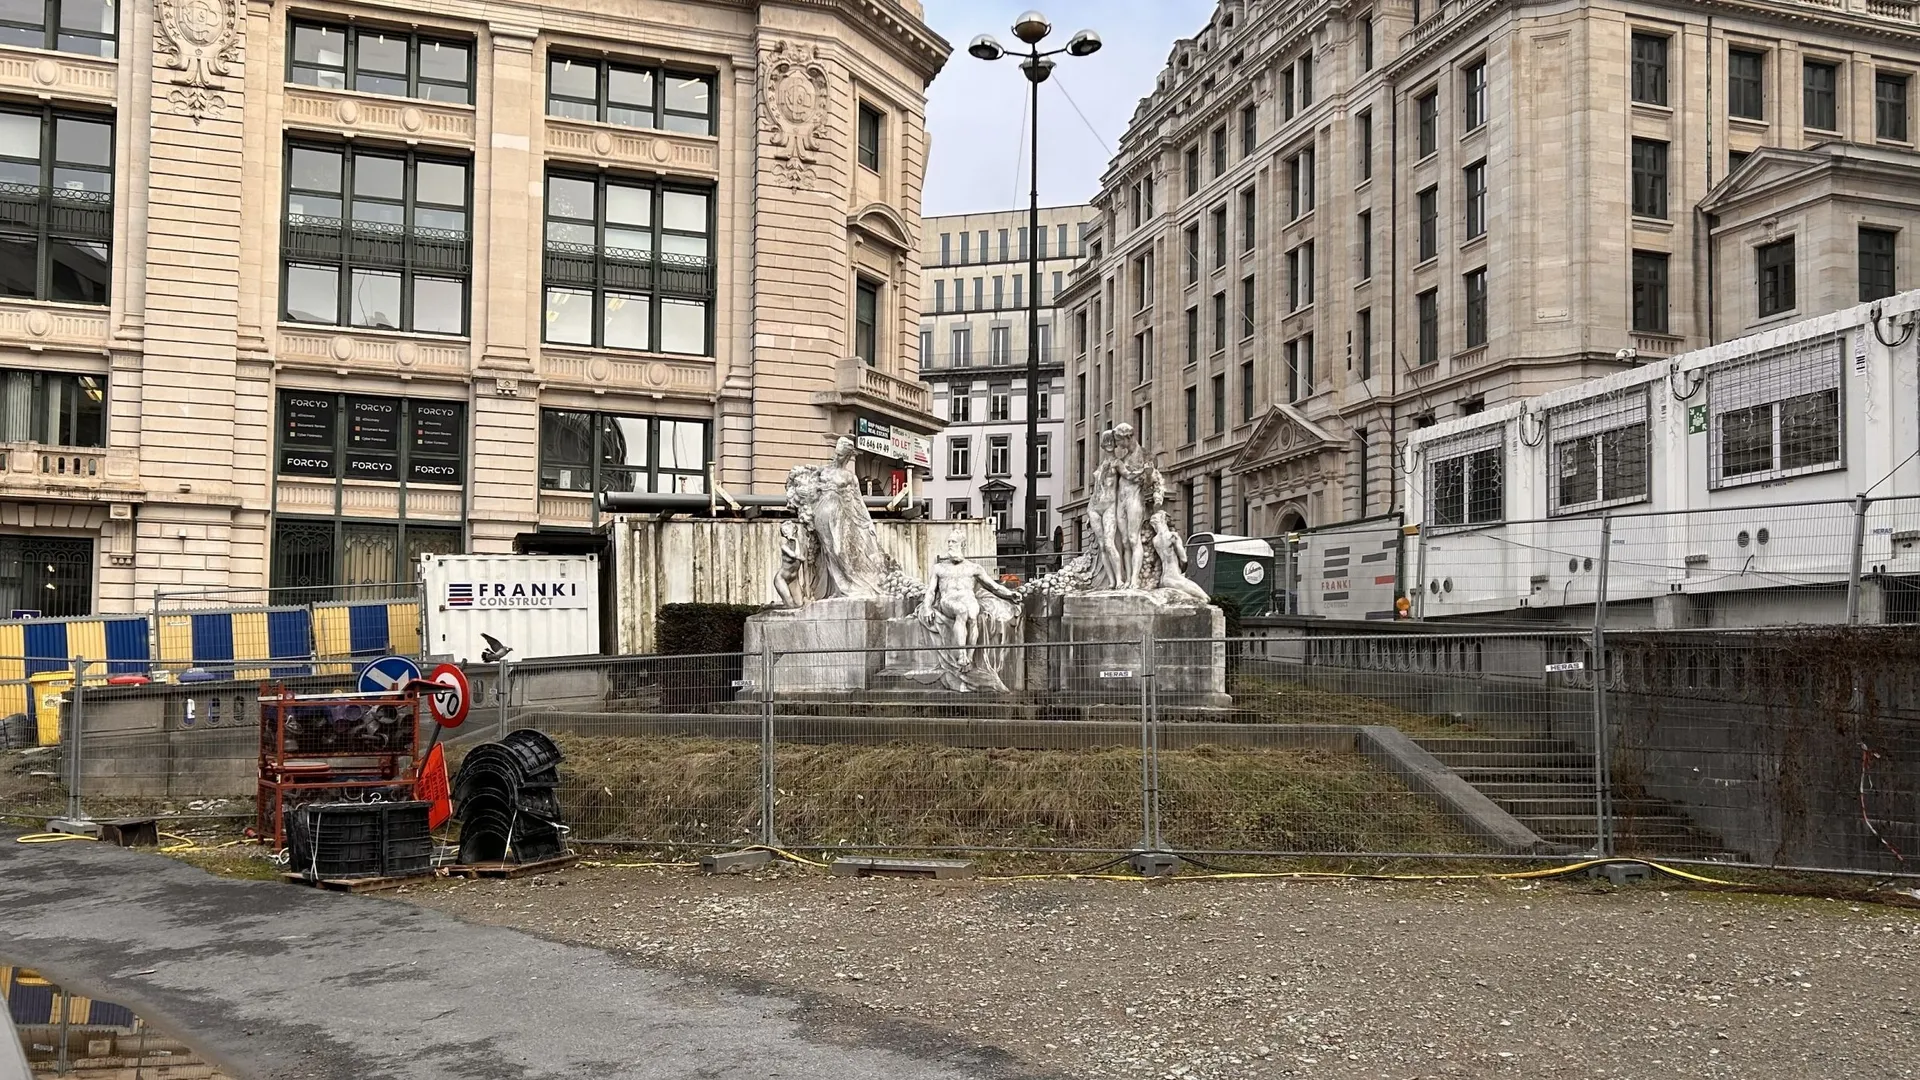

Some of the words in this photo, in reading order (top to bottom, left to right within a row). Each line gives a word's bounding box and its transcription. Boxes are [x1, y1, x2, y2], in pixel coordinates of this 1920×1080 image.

[290, 398, 328, 408] FORCYD
[355, 403, 392, 412] FORCYD
[418, 407, 454, 417] FORCYD
[859, 437, 865, 447] 02
[867, 439, 875, 449] 646
[876, 442, 882, 451] 49
[883, 444, 889, 453] 49
[892, 437, 900, 448] TO
[901, 439, 911, 450] LET
[287, 458, 328, 468] FORCYD
[352, 461, 393, 471] FORCYD
[415, 465, 454, 475] FORCYD
[479, 583, 576, 596] FRANKI
[1321, 579, 1351, 591] FRANKI
[479, 597, 554, 606] CONSTRUCT
[1550, 662, 1580, 671] HERAS
